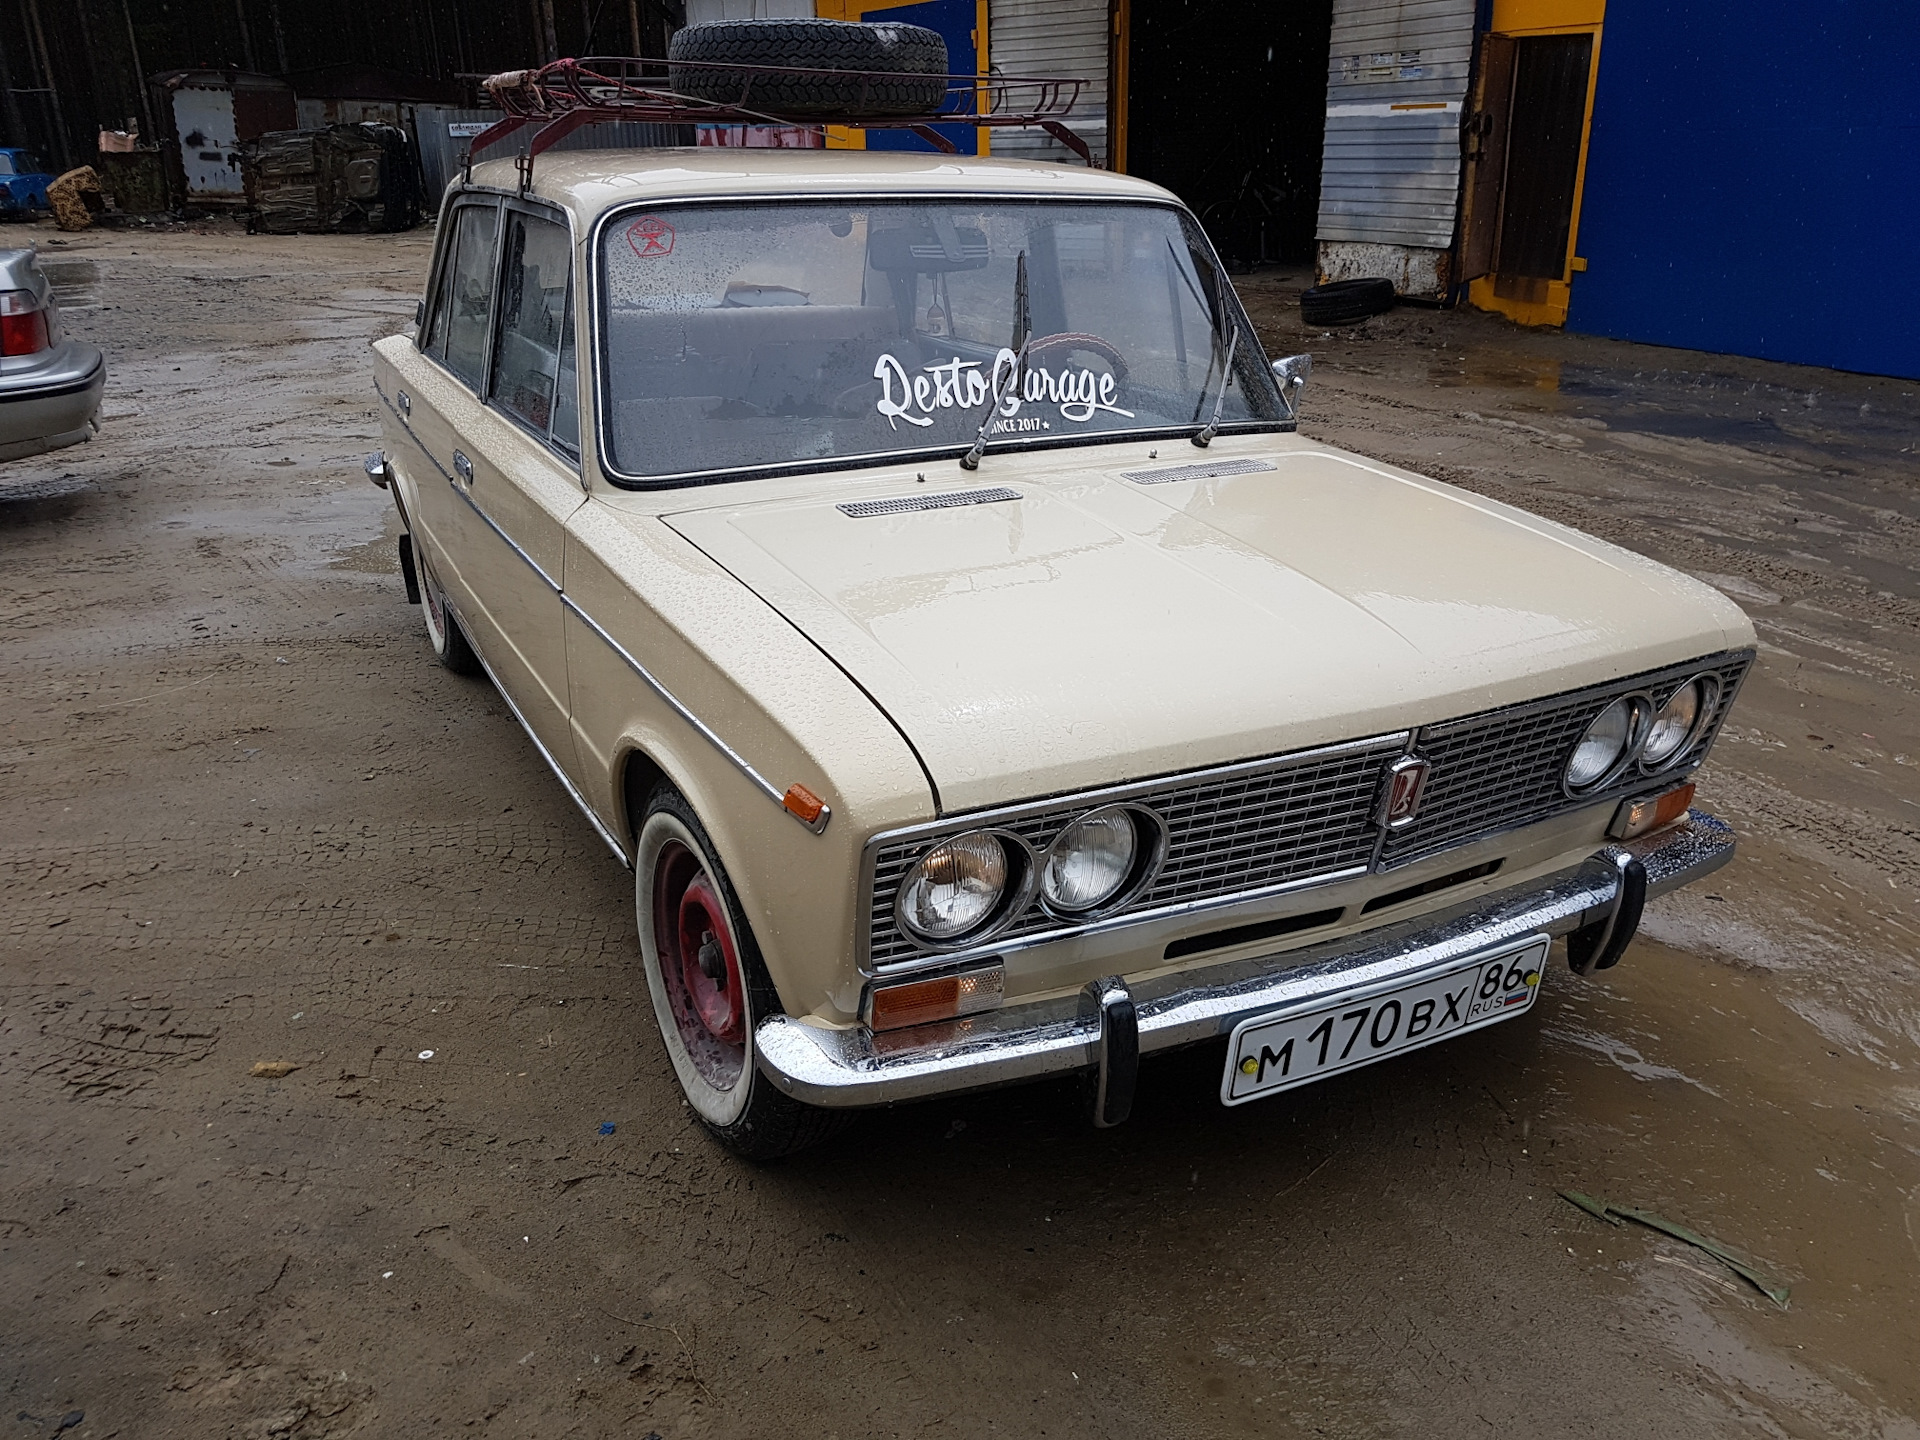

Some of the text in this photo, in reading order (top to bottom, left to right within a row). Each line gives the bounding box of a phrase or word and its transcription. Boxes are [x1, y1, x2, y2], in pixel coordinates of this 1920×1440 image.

[1017, 417, 1040, 432] 2017
[1479, 955, 1524, 1000] 86
[1470, 997, 1505, 1017] RUS
